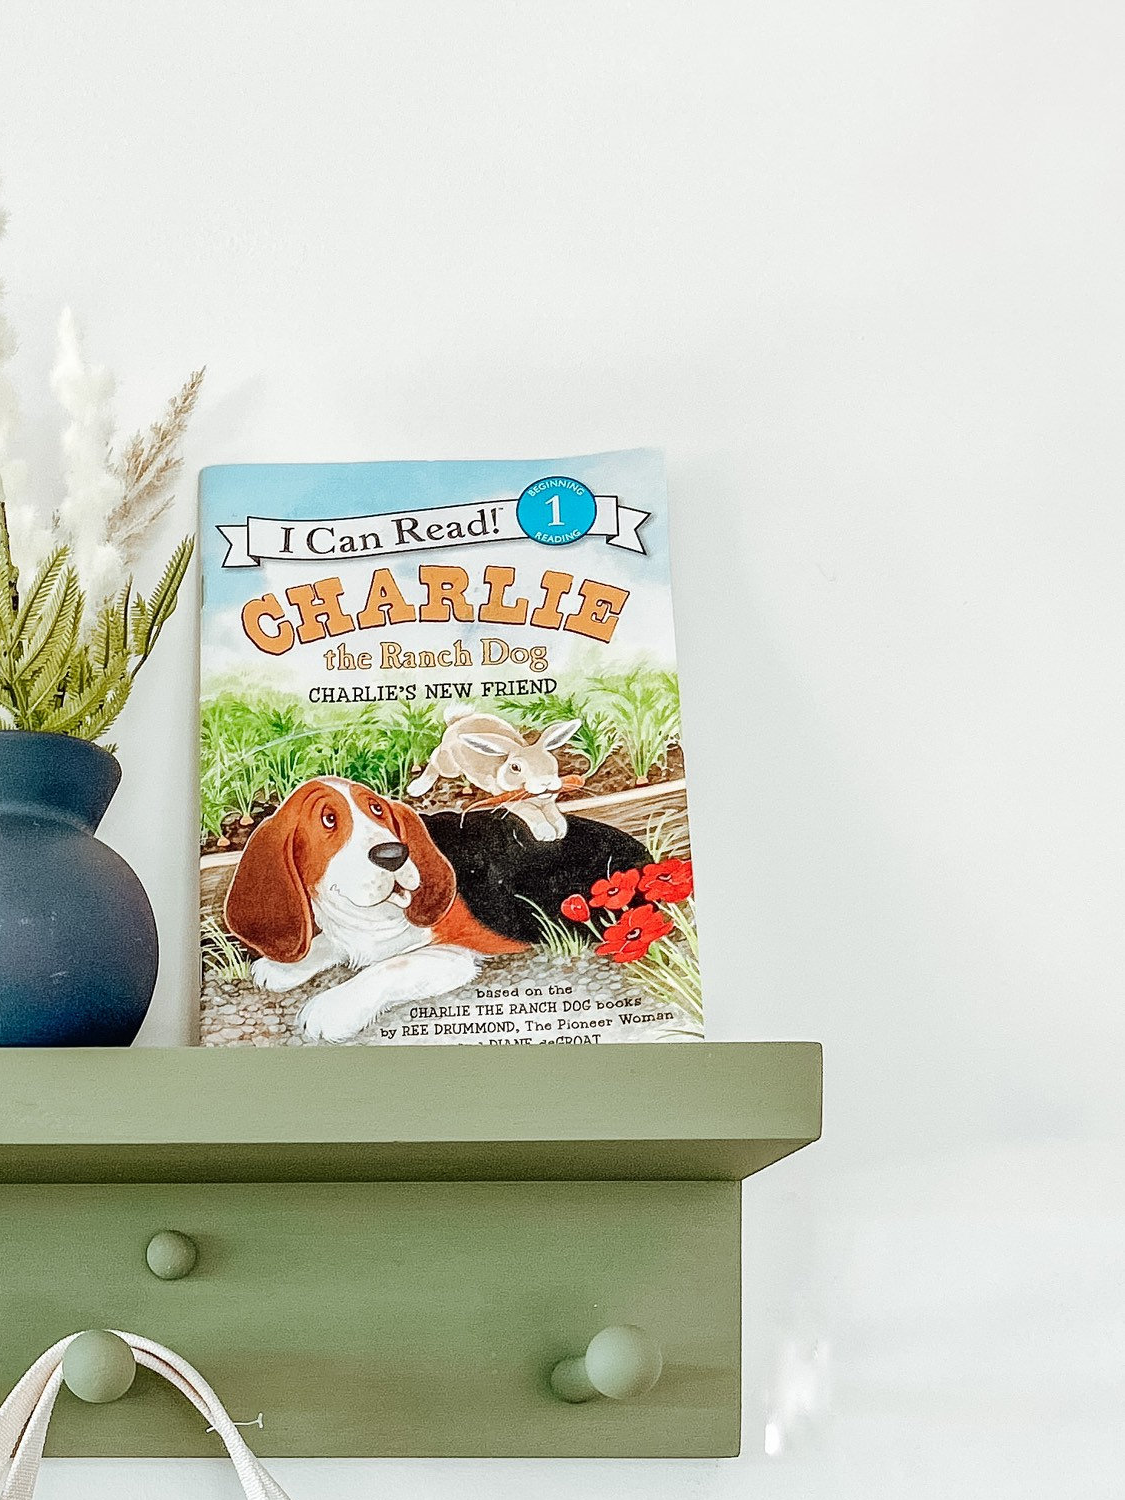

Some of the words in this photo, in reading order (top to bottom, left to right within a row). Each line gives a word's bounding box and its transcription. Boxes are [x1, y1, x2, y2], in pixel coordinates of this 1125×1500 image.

[527, 480, 585, 497] BEGINNING
[545, 495, 565, 526] 1
[279, 525, 294, 554] I
[306, 526, 383, 555] Can
[392, 507, 501, 546] Read!
[535, 529, 582, 543] READING
[240, 564, 631, 656] CHARLIE
[324, 644, 372, 670] the
[380, 640, 472, 669] Ranch
[481, 638, 549, 673] Dog
[308, 683, 417, 704] CHARLIE'S
[424, 681, 471, 700] NEW
[481, 678, 557, 698] FRIEND
[475, 987, 519, 998] based
[525, 988, 543, 997] on
[549, 984, 573, 995] the
[409, 1005, 470, 1019] CHARLIE
[475, 1004, 503, 1016] THE
[509, 1002, 557, 1015] RANCH
[563, 1000, 591, 1013] DOG
[596, 997, 642, 1010] books
[380, 1028, 397, 1040] by
[401, 1024, 429, 1037] REE
[434, 1021, 520, 1035] DRUMMOND,
[524, 1020, 552, 1032] The
[557, 1017, 613, 1030] Pioneer
[618, 1011, 674, 1025] Woman
